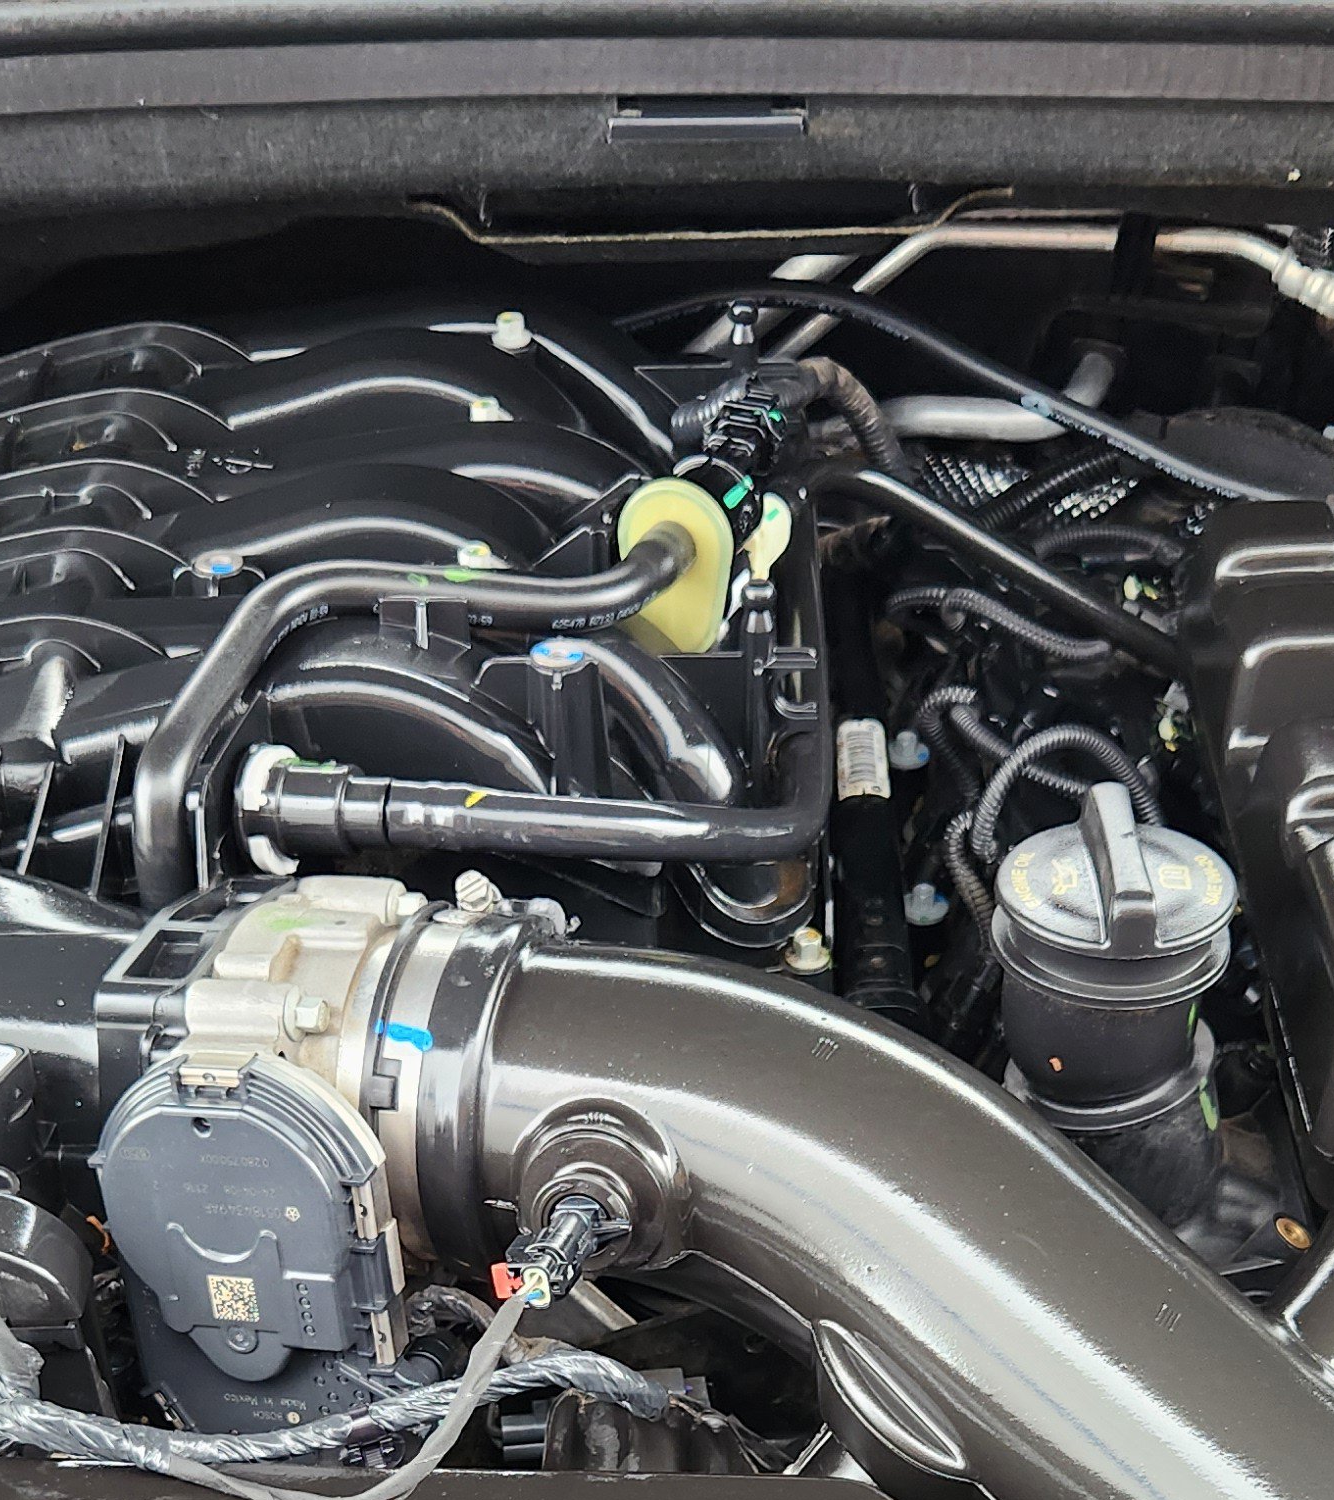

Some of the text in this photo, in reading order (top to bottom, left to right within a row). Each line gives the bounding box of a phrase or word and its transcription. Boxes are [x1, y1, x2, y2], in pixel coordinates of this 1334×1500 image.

[223, 1393, 258, 1406] Mexico
[280, 1398, 307, 1411] Made
[252, 1410, 284, 1421] BOSCH
